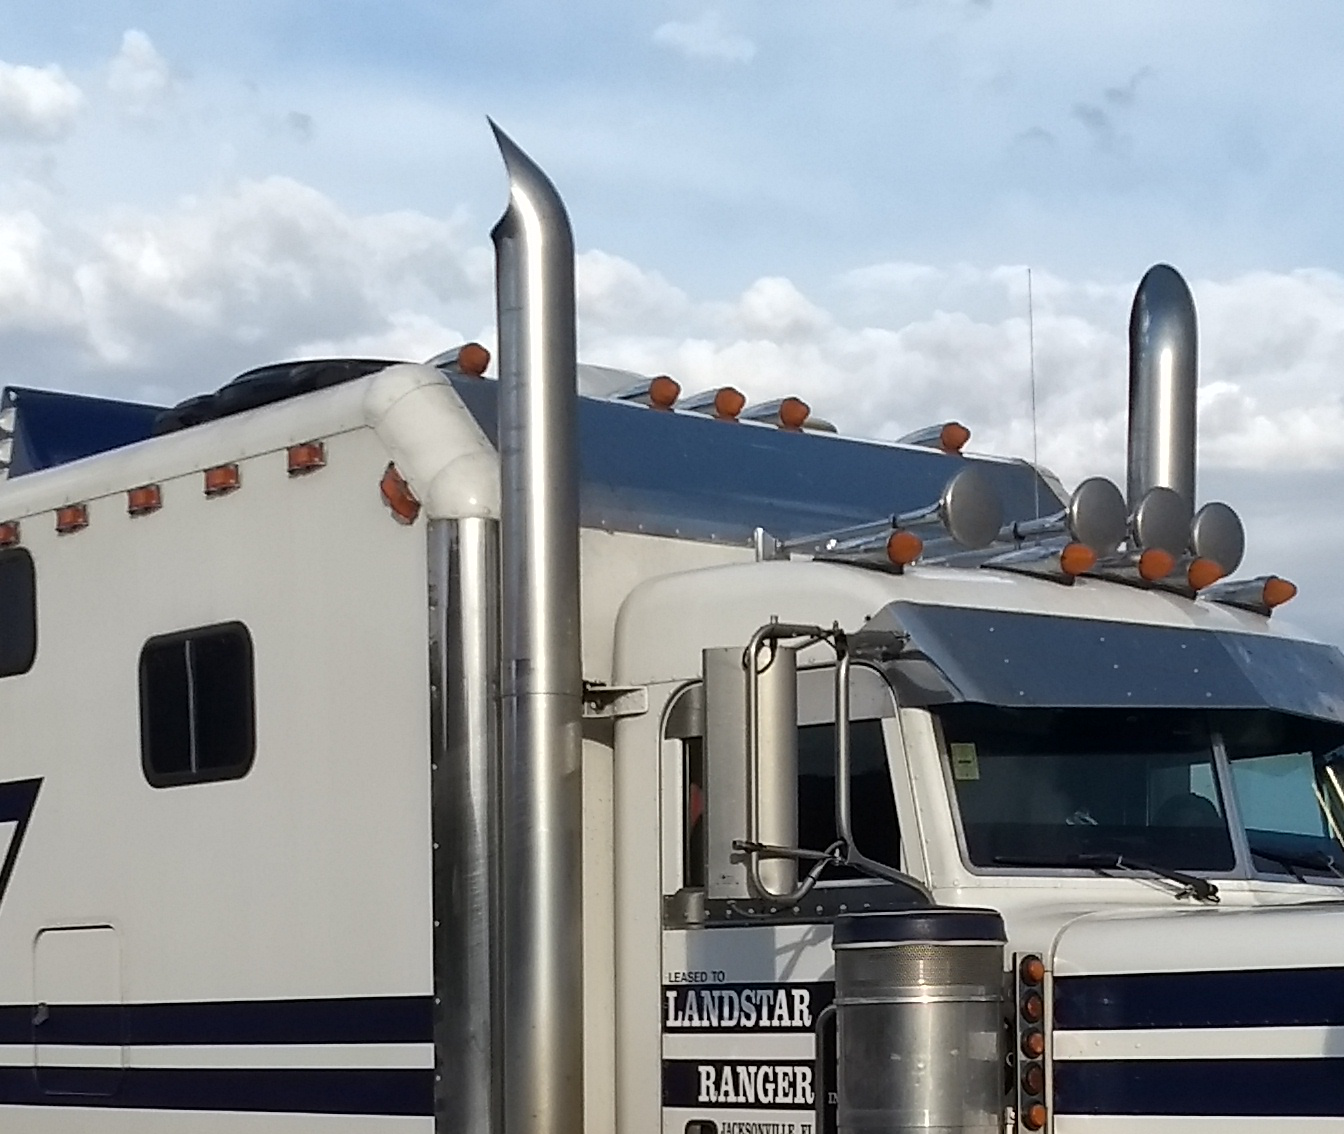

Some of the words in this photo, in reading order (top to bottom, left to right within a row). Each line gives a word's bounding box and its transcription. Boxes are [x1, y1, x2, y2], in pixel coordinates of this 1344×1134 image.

[668, 971, 708, 983] LEASED
[711, 971, 725, 982] TO
[665, 988, 812, 1027] LANDSTAR
[698, 1065, 815, 1104] RANGER
